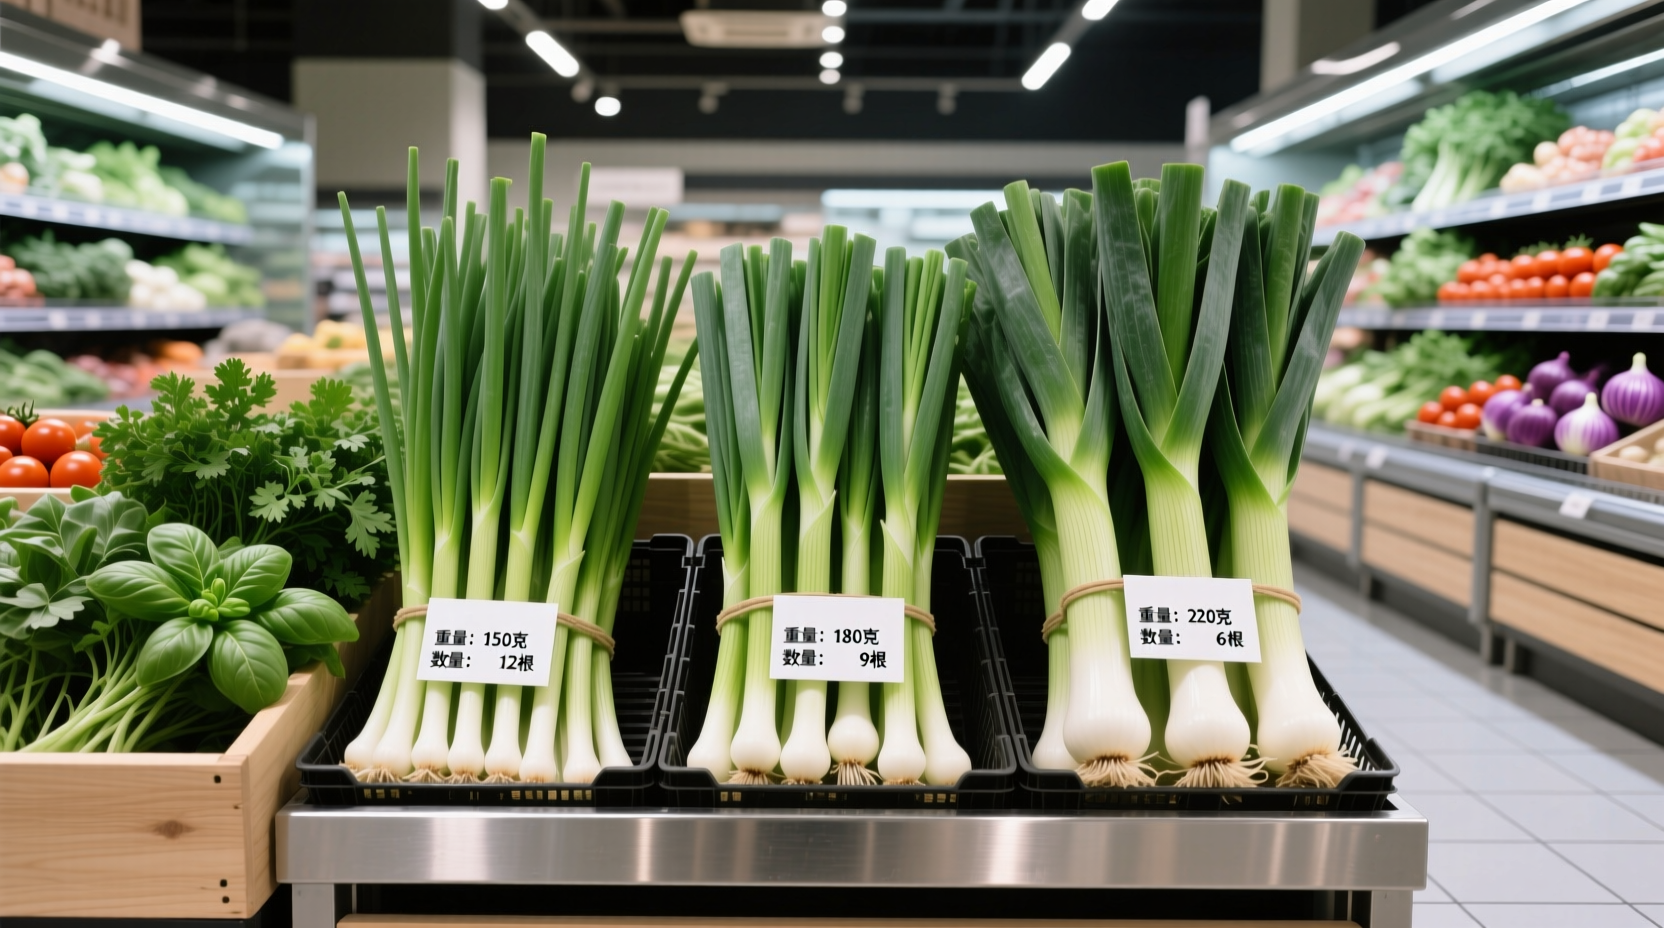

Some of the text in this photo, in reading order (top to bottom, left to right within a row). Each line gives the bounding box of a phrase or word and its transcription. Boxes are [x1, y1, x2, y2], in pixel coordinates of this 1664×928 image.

[1187, 607, 1232, 626] 220克
[484, 630, 529, 649] 150克
[834, 627, 880, 645] 180克
[1216, 630, 1244, 648] 6根
[499, 653, 534, 672] 12根
[859, 649, 887, 669] 9根
